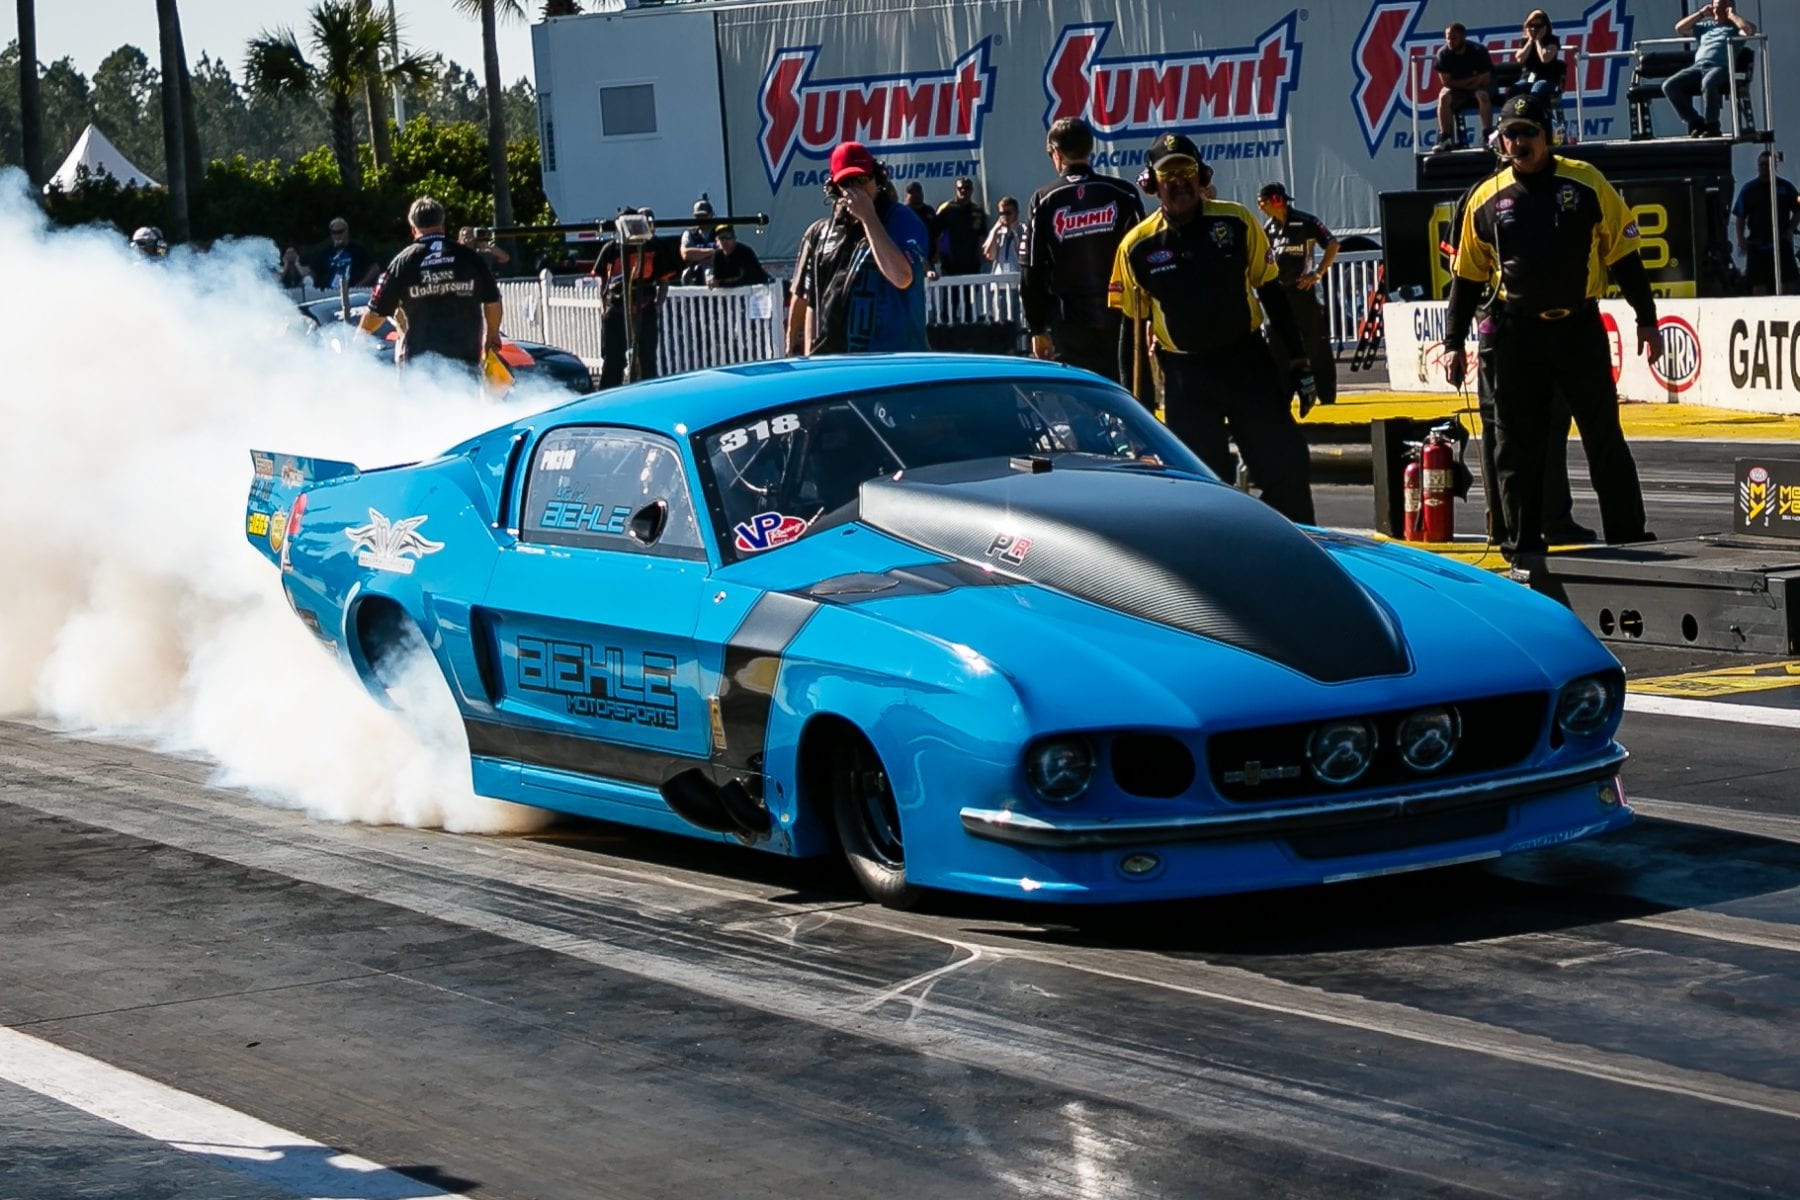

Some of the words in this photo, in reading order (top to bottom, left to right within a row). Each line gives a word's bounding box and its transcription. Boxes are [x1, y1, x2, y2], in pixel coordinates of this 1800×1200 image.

[886, 158, 980, 180] QUIPMENT
[719, 413, 800, 452] 318
[734, 511, 784, 550] VP
[566, 694, 679, 730] MOTORSPORTS
